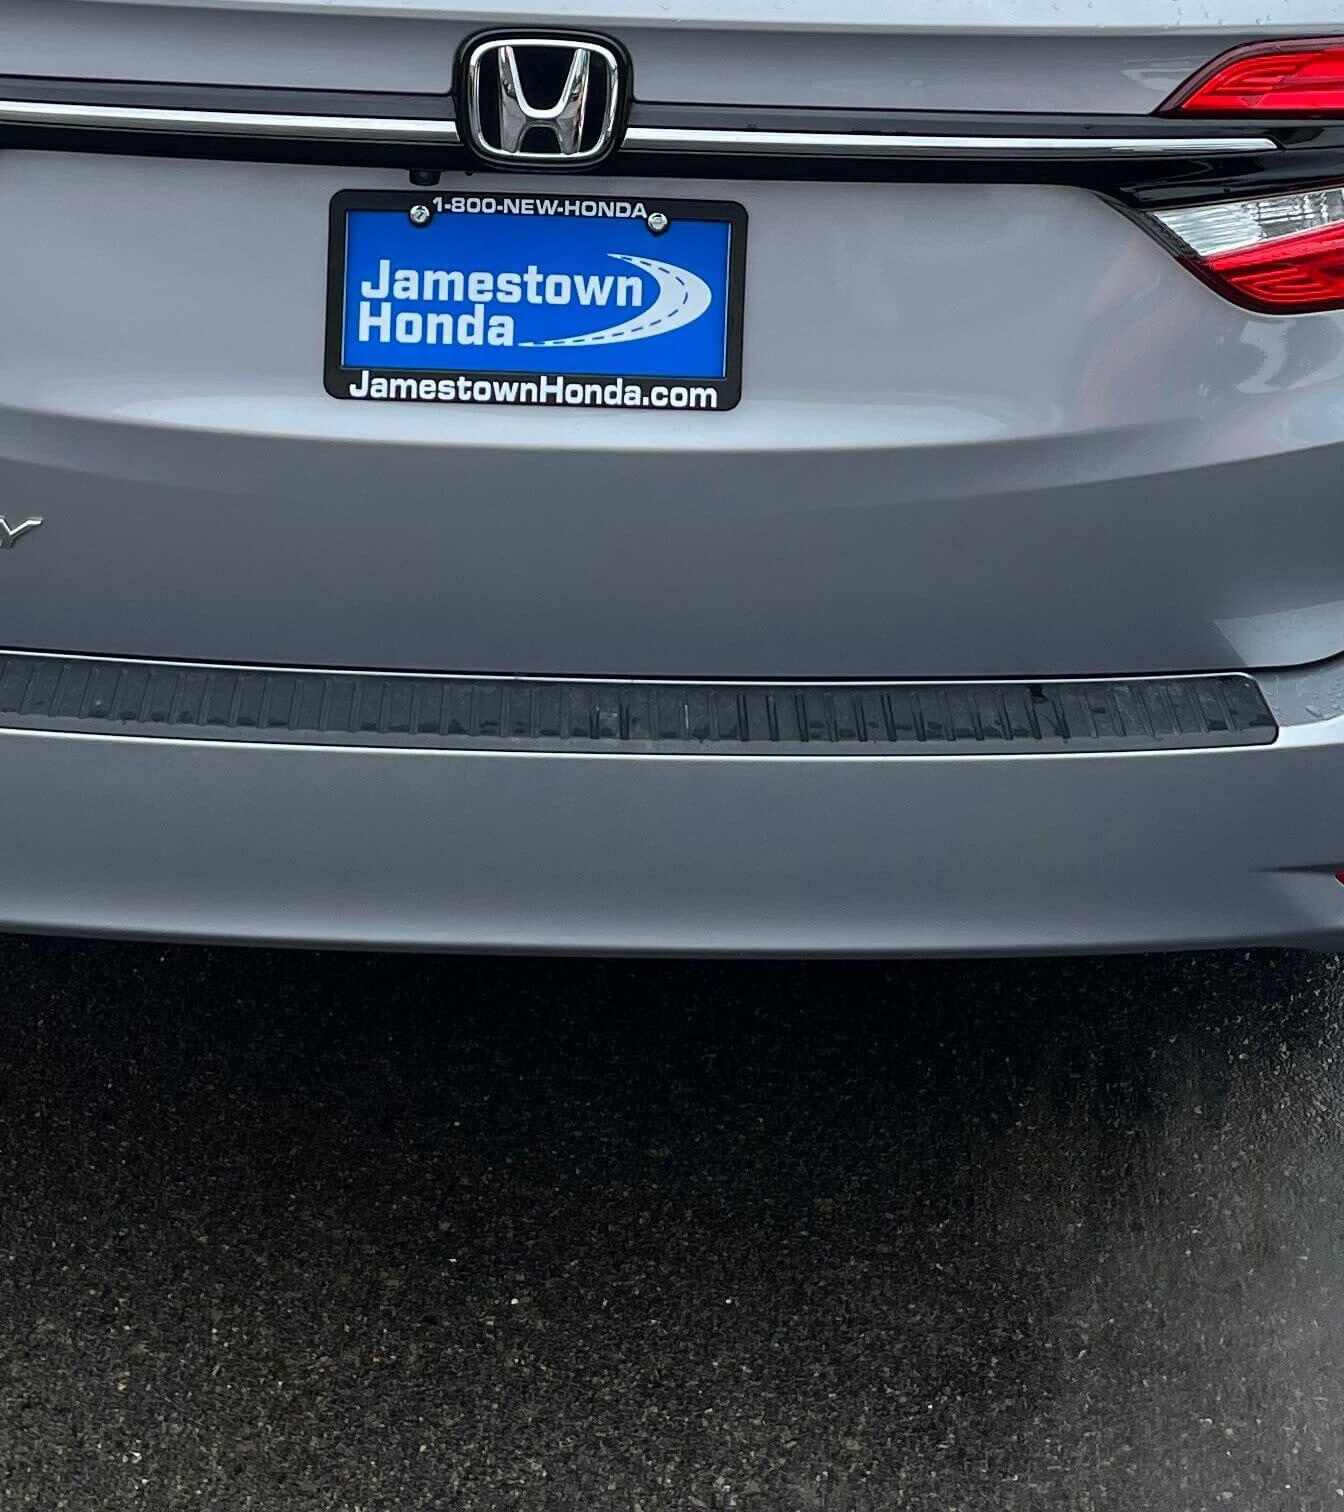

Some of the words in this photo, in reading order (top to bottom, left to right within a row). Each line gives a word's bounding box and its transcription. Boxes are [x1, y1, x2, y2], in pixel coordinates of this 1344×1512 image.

[432, 196, 647, 219] 1-800-NEW-HONDA
[360, 259, 643, 307] Jamestown
[358, 300, 515, 347] Honda
[349, 370, 718, 408] JamestownHonda.com
